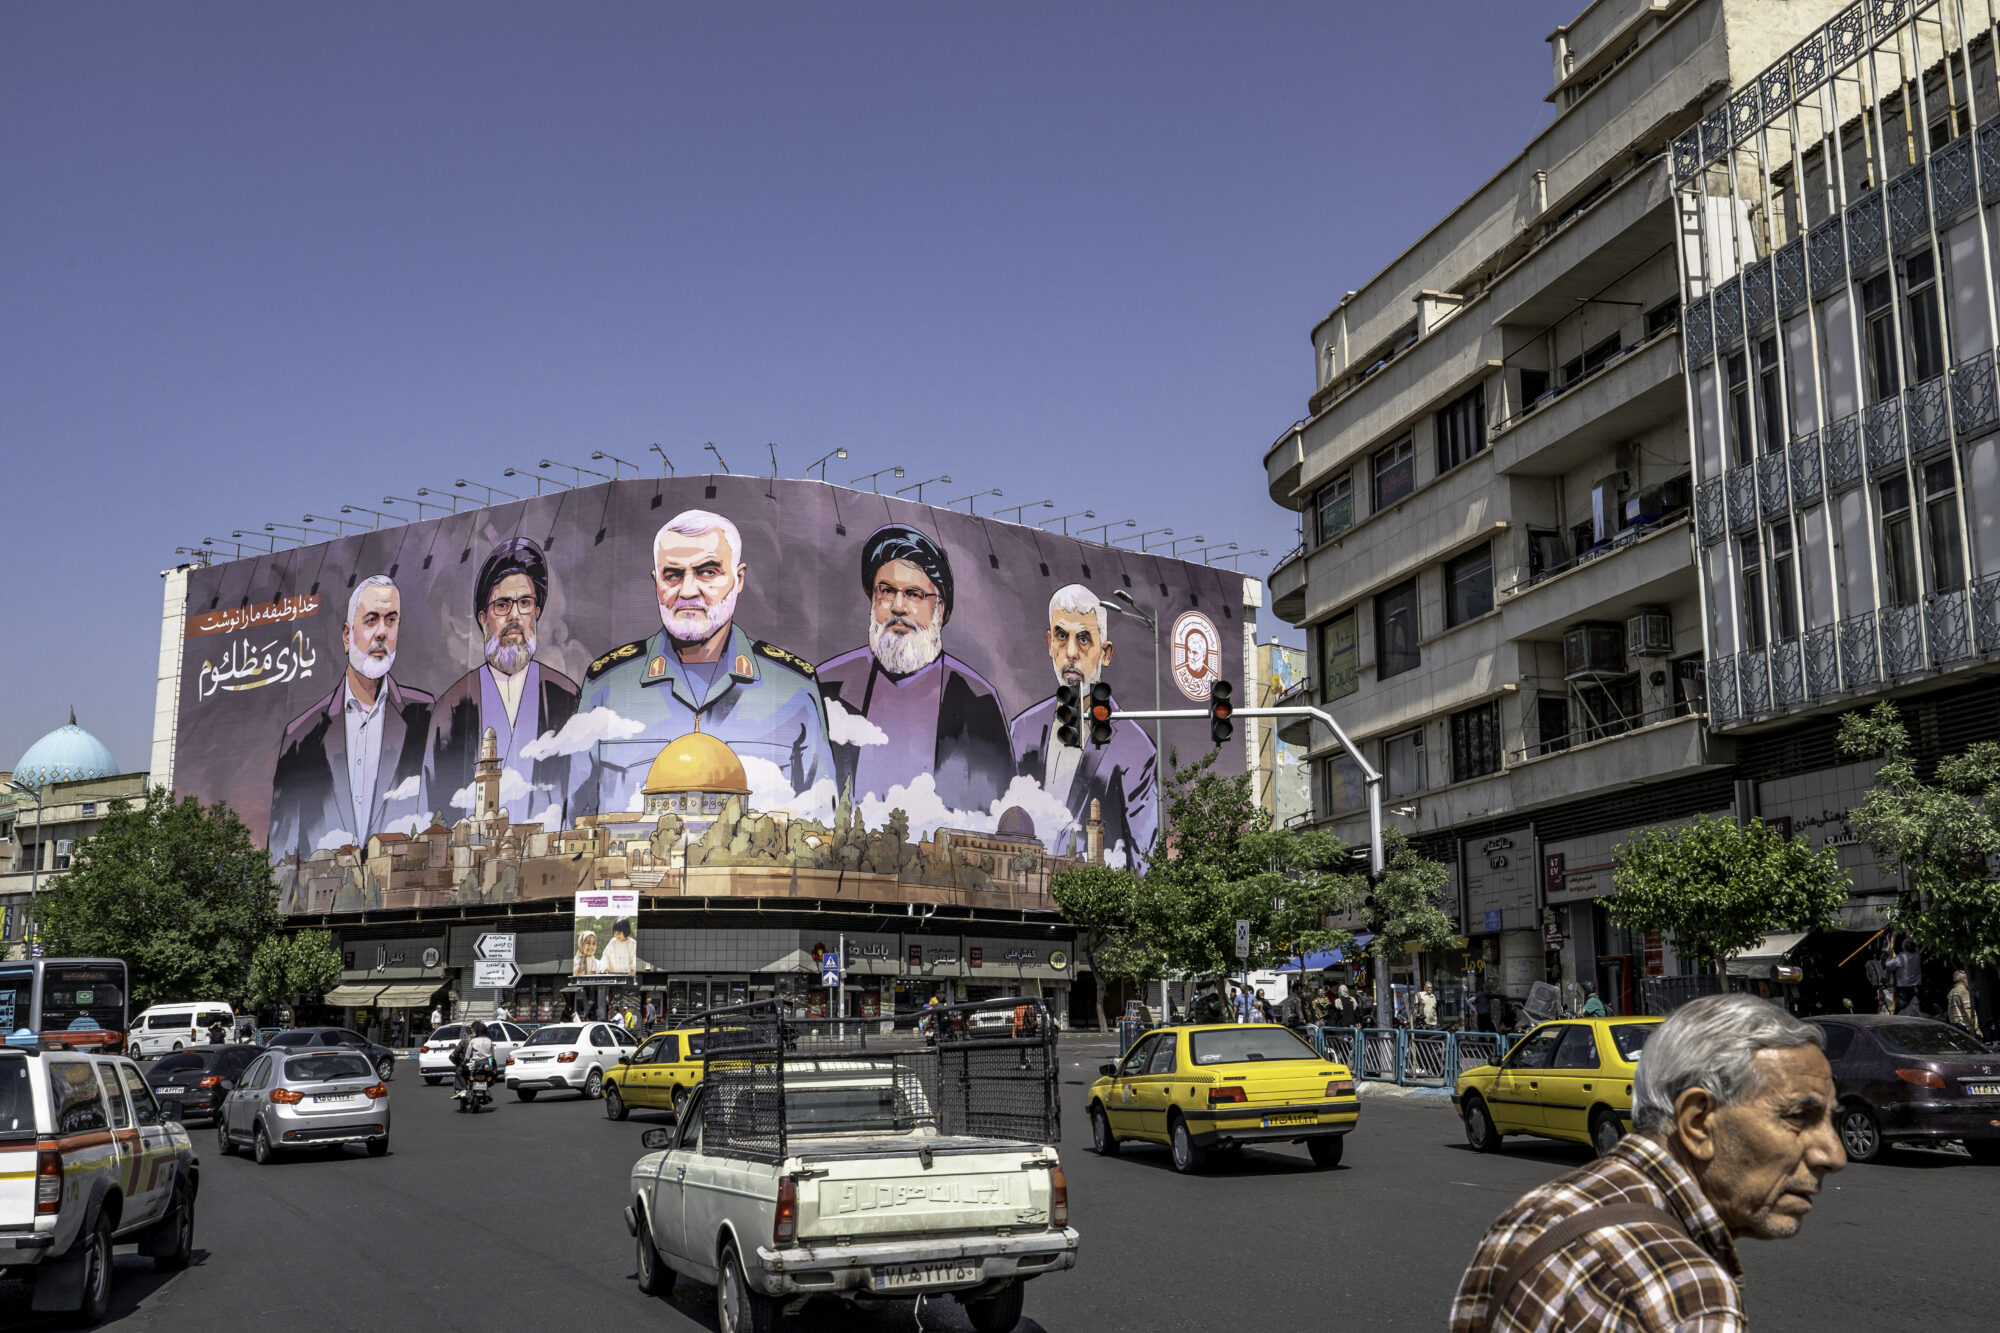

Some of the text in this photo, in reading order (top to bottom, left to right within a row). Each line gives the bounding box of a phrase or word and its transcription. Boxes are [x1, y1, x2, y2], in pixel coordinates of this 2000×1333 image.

[262, 598, 297, 622] وظیفه
[298, 594, 318, 614] خدا
[200, 611, 240, 634] نوشت
